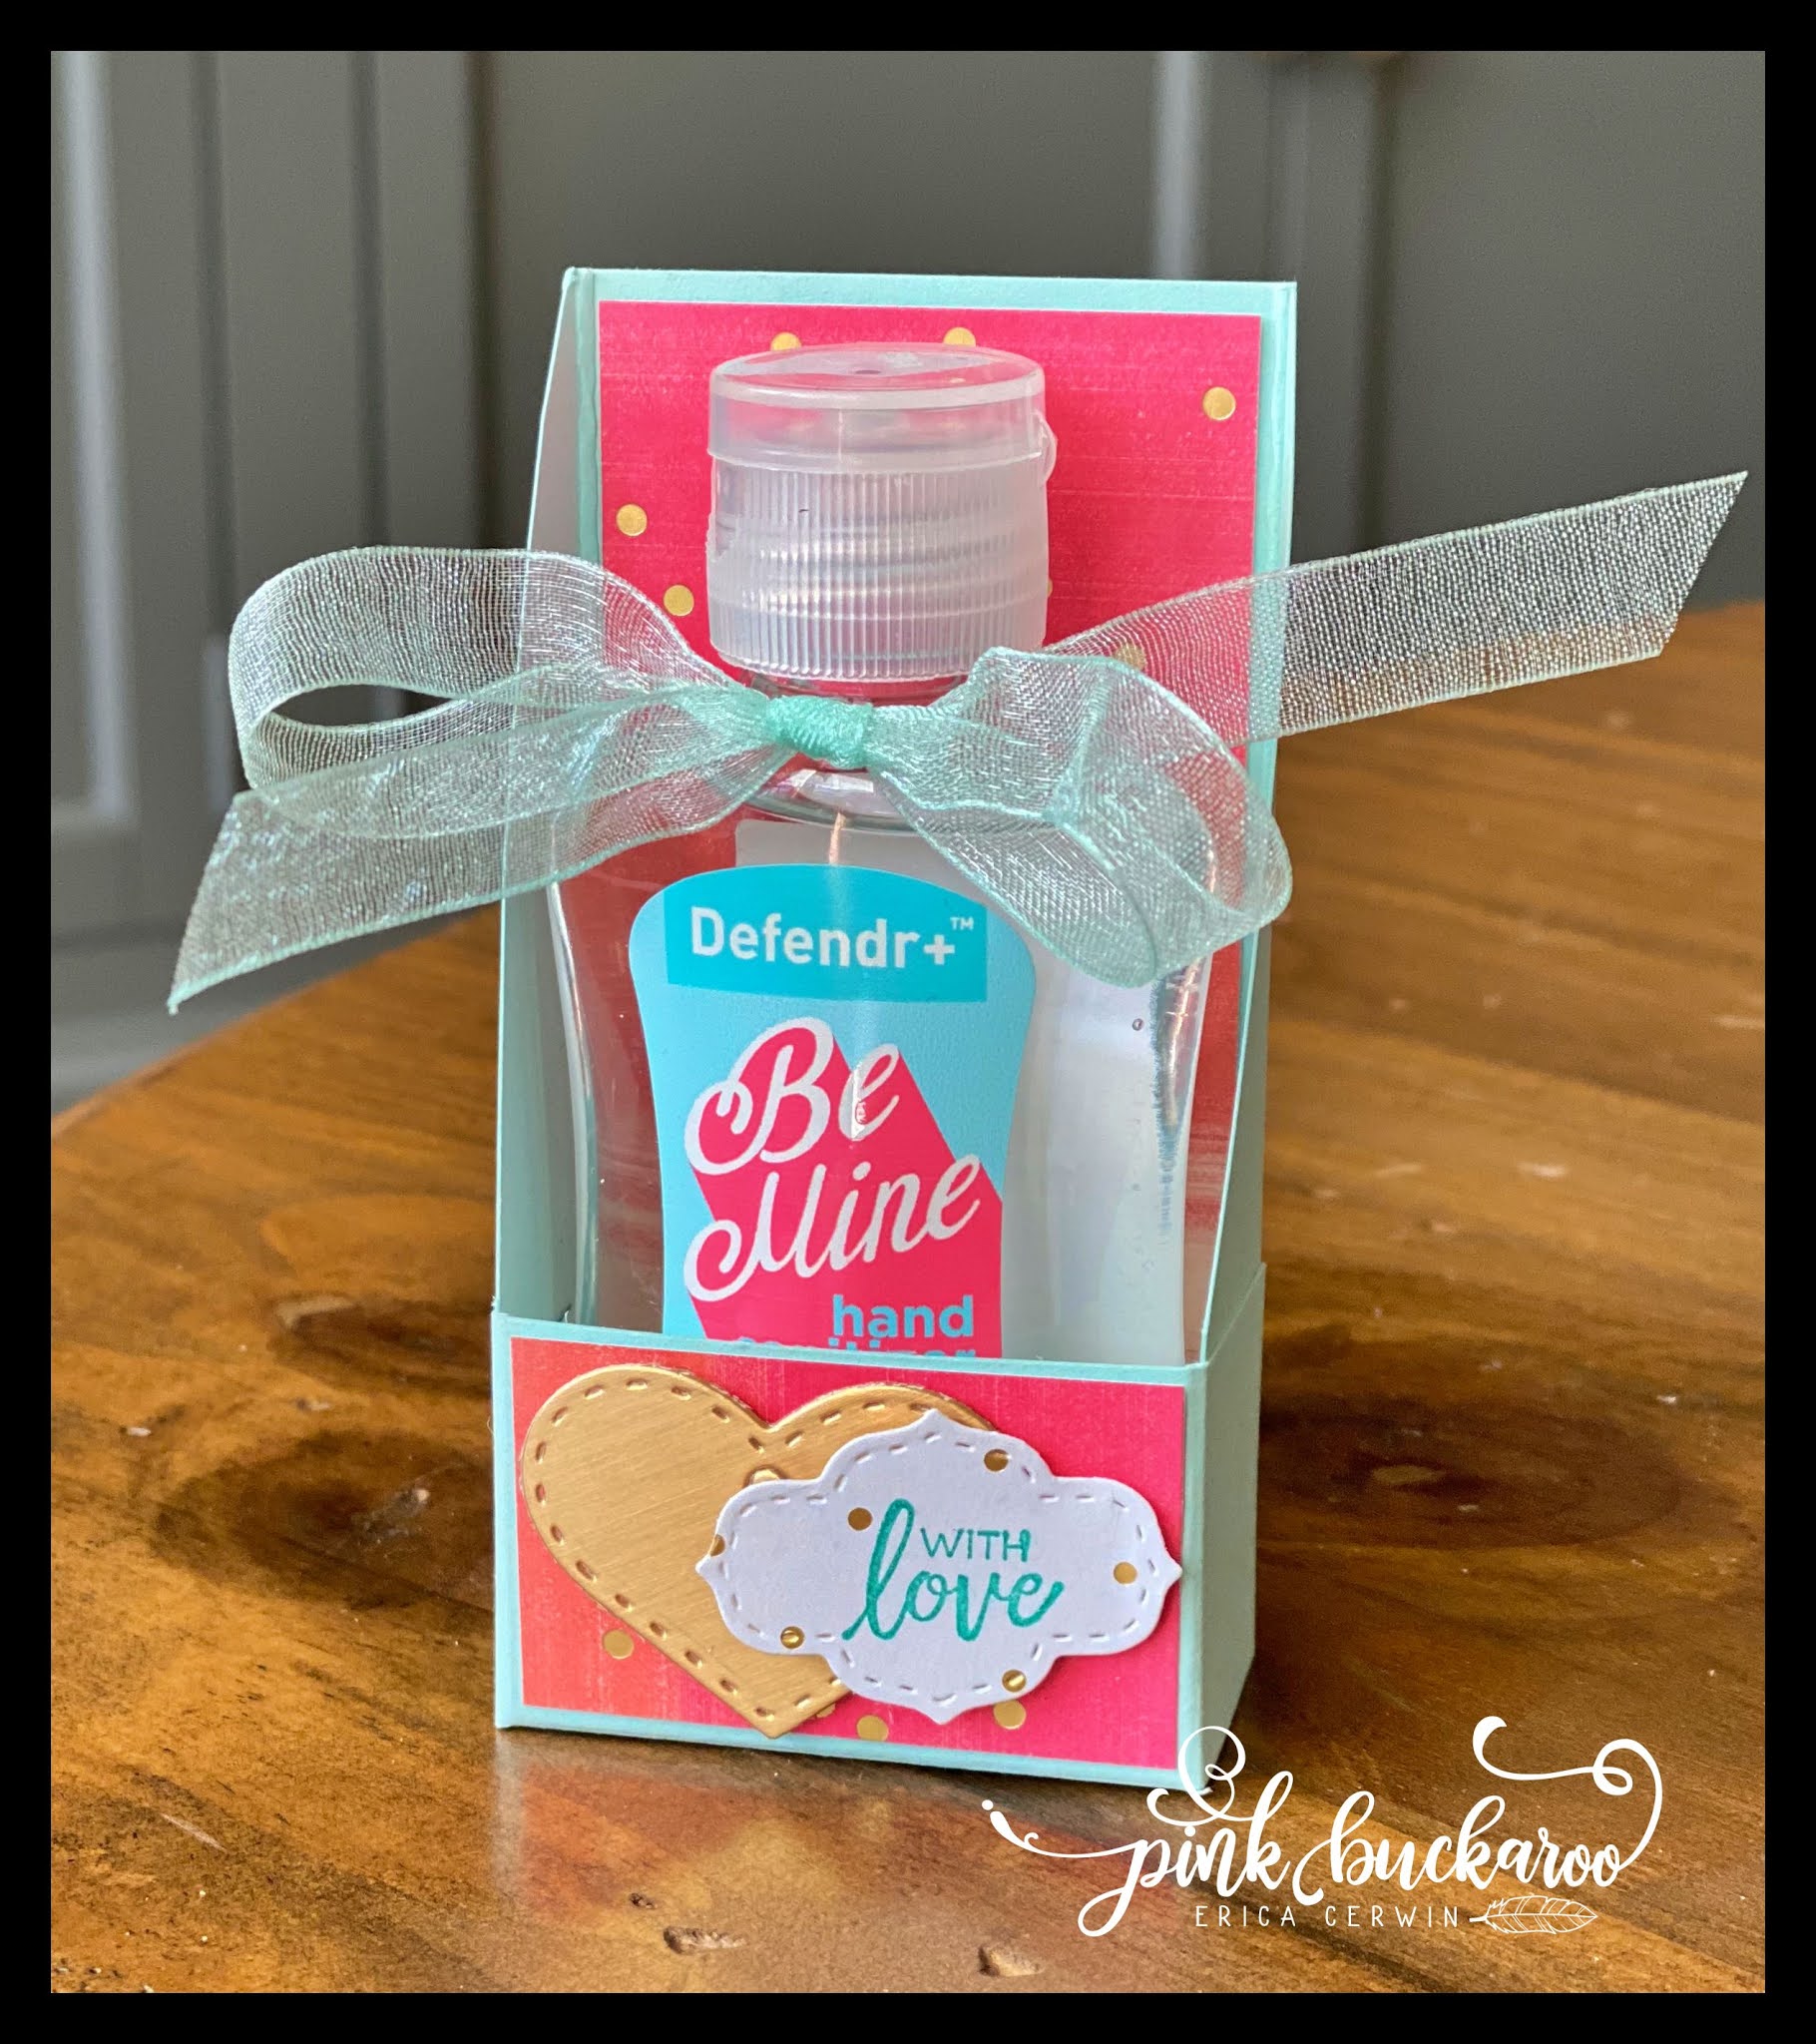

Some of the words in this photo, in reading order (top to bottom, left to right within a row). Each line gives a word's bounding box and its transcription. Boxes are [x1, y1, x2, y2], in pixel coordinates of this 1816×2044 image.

[690, 905, 955, 968] Defendr+
[683, 1016, 900, 1175] Be
[683, 1154, 982, 1301] Mine
[832, 1293, 974, 1337] hand
[841, 1497, 1065, 1642] love
[920, 1528, 1032, 1563] WITH
